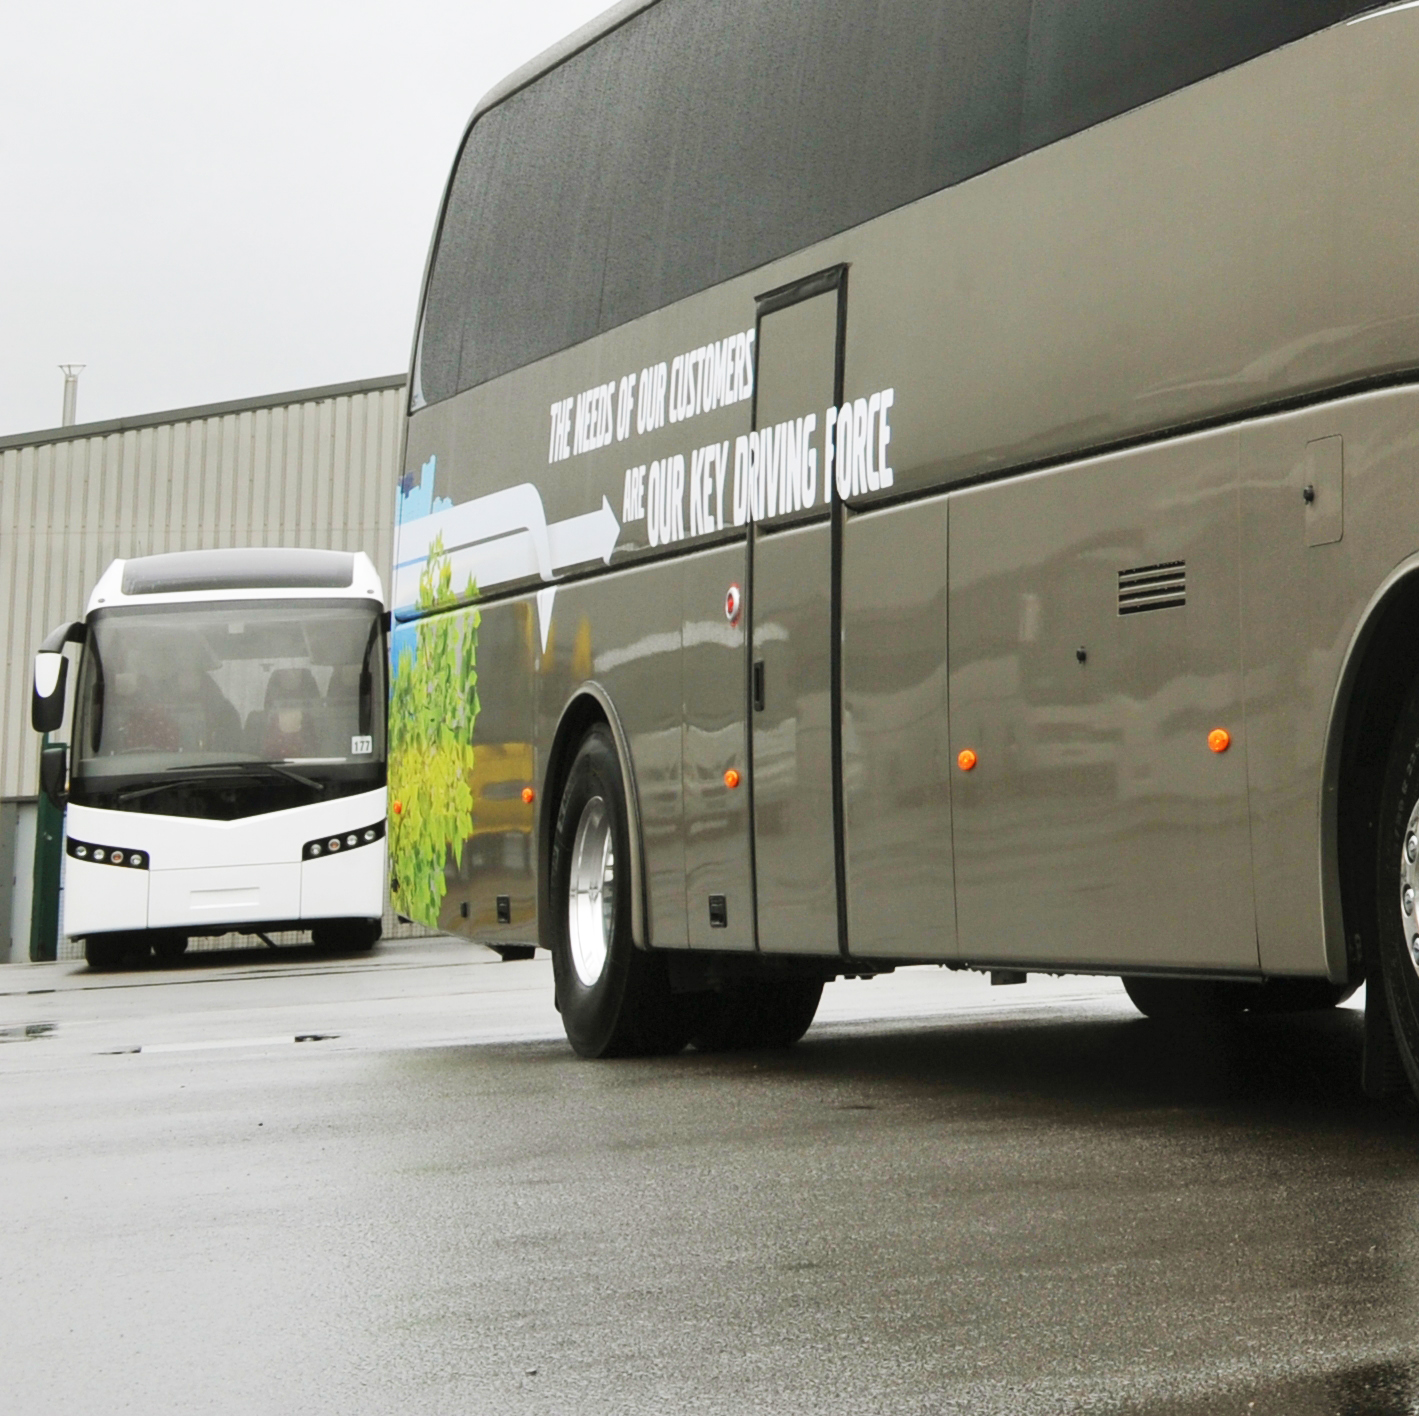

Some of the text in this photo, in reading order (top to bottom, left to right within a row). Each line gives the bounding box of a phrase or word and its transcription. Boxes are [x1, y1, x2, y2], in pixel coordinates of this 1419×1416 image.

[548, 328, 756, 464] THE NEEDS OF OUR CUSTOMERS
[622, 388, 894, 547] ARE OUR KEY DRIVING FORCE
[354, 740, 370, 752] 177
